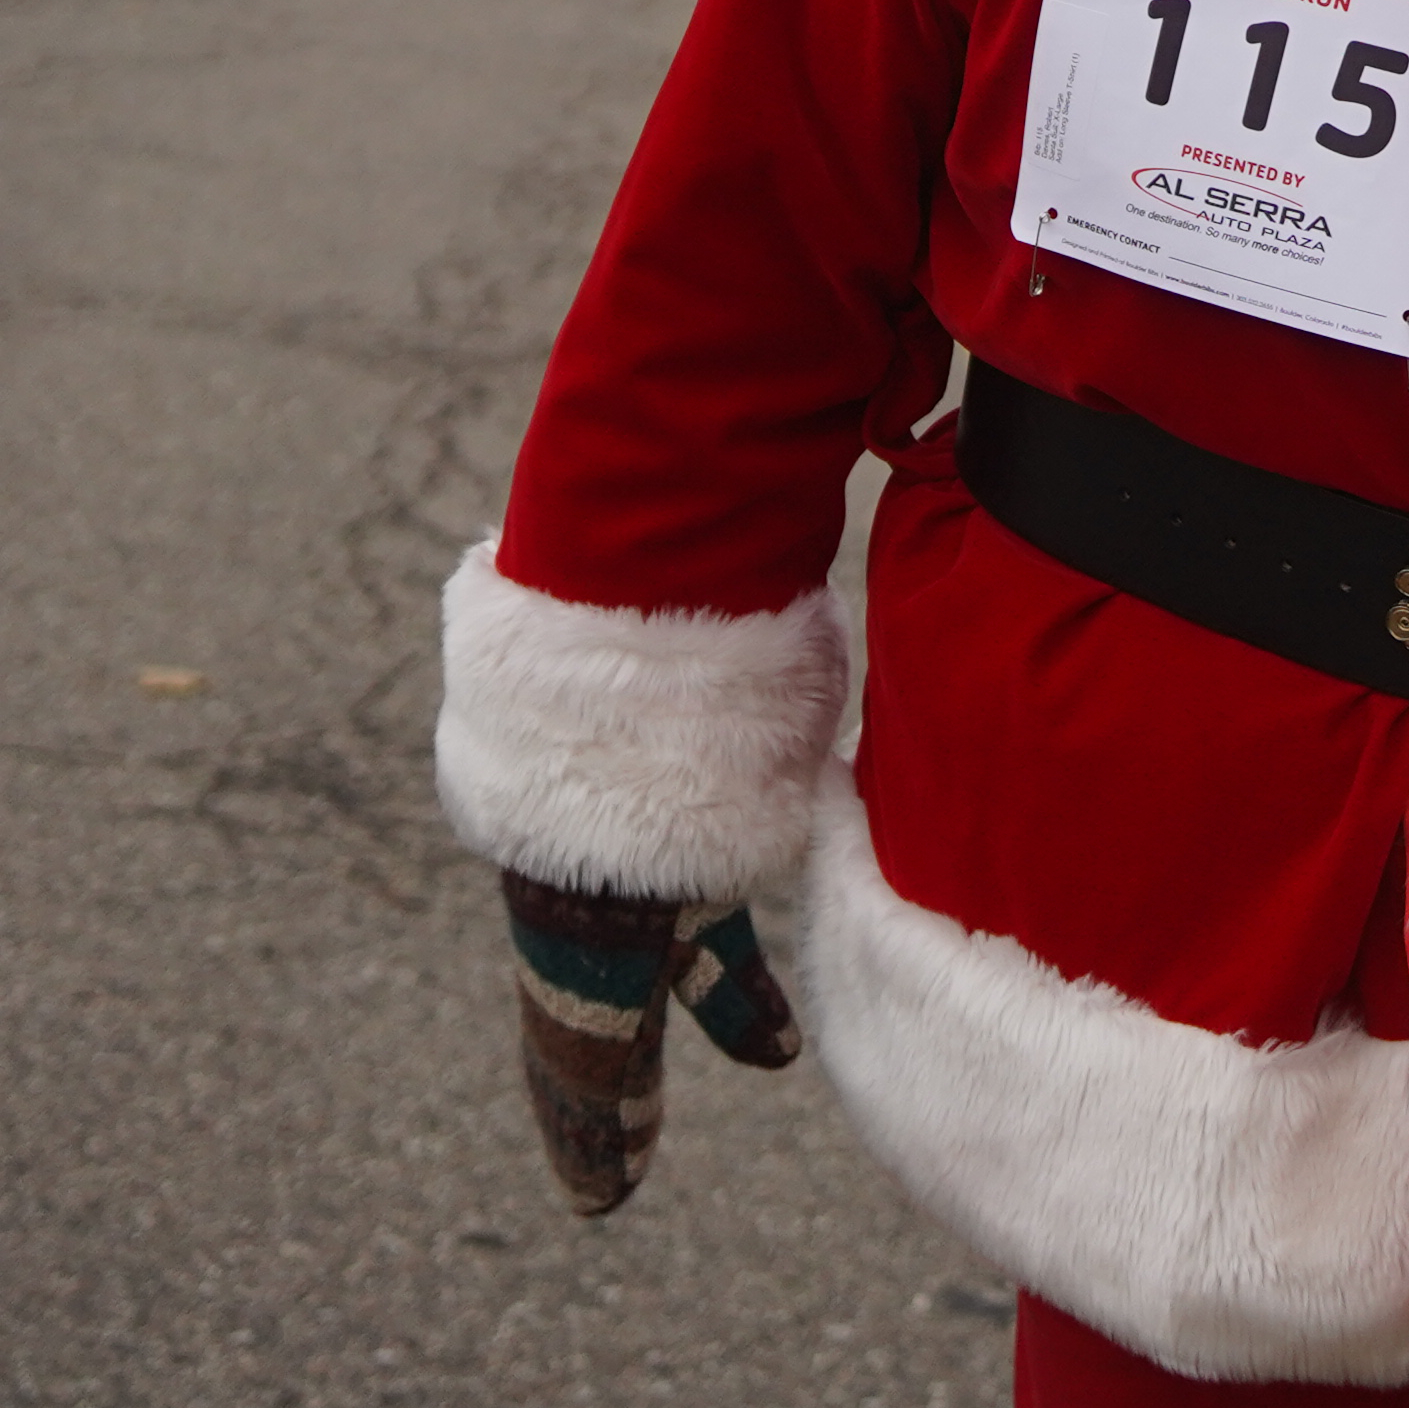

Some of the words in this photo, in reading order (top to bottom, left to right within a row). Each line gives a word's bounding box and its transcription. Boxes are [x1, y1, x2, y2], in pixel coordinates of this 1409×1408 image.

[1060, 117, 1069, 136] Long
[1066, 64, 1077, 89] T-Shirt
[1181, 144, 1278, 182] PRESENTED
[1282, 171, 1306, 189] BY
[1146, 173, 1195, 201] AL
[1204, 187, 1332, 238] SERRA
[1196, 210, 1252, 233] AUTO
[1261, 227, 1326, 253] PLAZA
[1066, 215, 1118, 240] EMERGENCY
[1120, 234, 1161, 254] CONTACT
[1126, 203, 1146, 217] One
[1147, 209, 1202, 234] destination.
[1205, 226, 1219, 238] So
[1221, 232, 1250, 248] many
[1251, 240, 1279, 254] more
[1281, 247, 1325, 266] choices!
